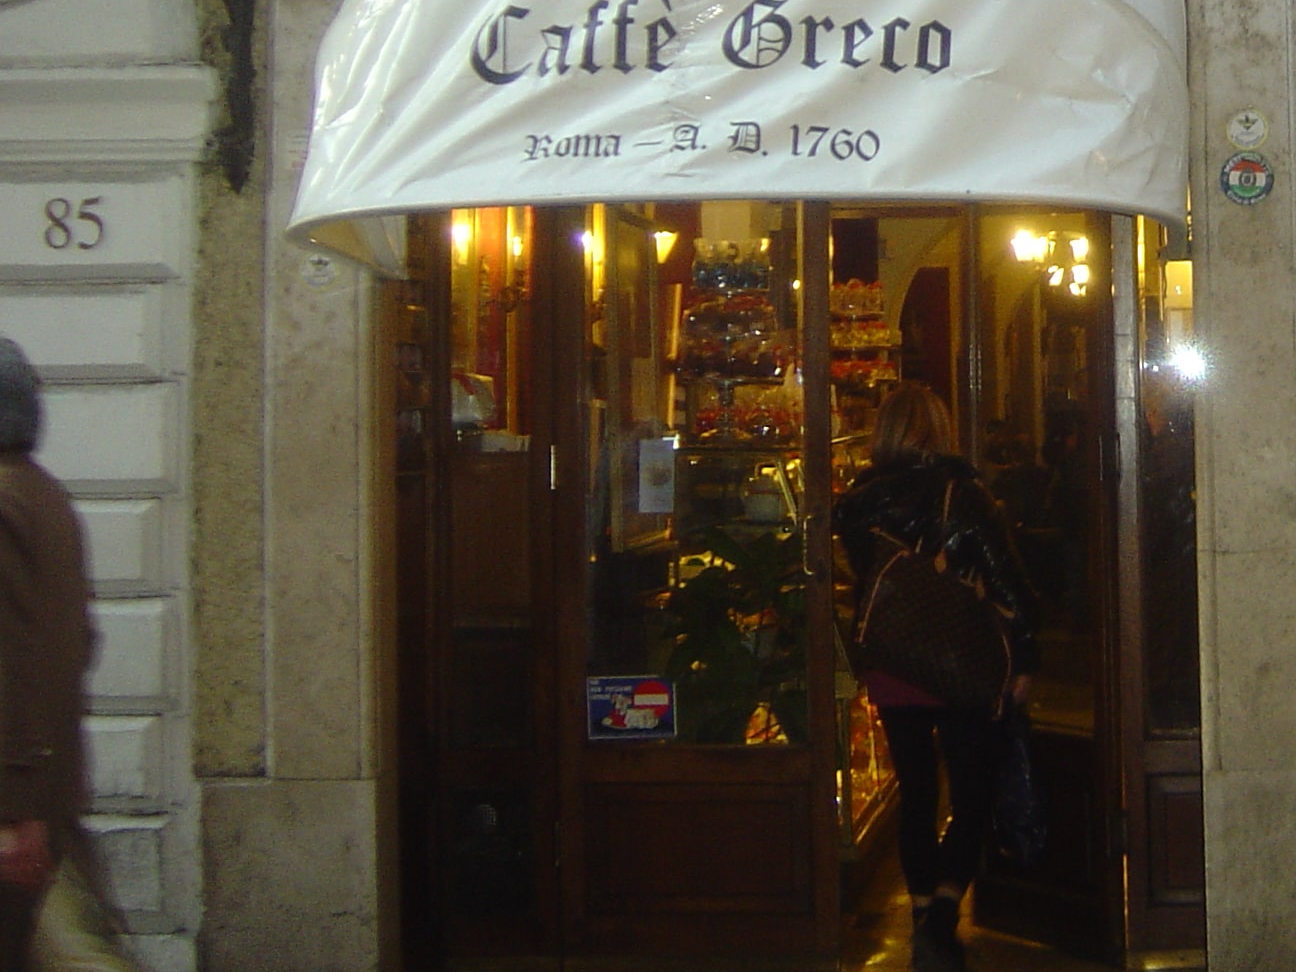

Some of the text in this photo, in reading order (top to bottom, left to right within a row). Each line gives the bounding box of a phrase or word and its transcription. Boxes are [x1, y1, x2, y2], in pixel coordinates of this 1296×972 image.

[523, 133, 622, 163] Roma
[790, 124, 881, 162] 1760
[45, 196, 104, 250] 85
